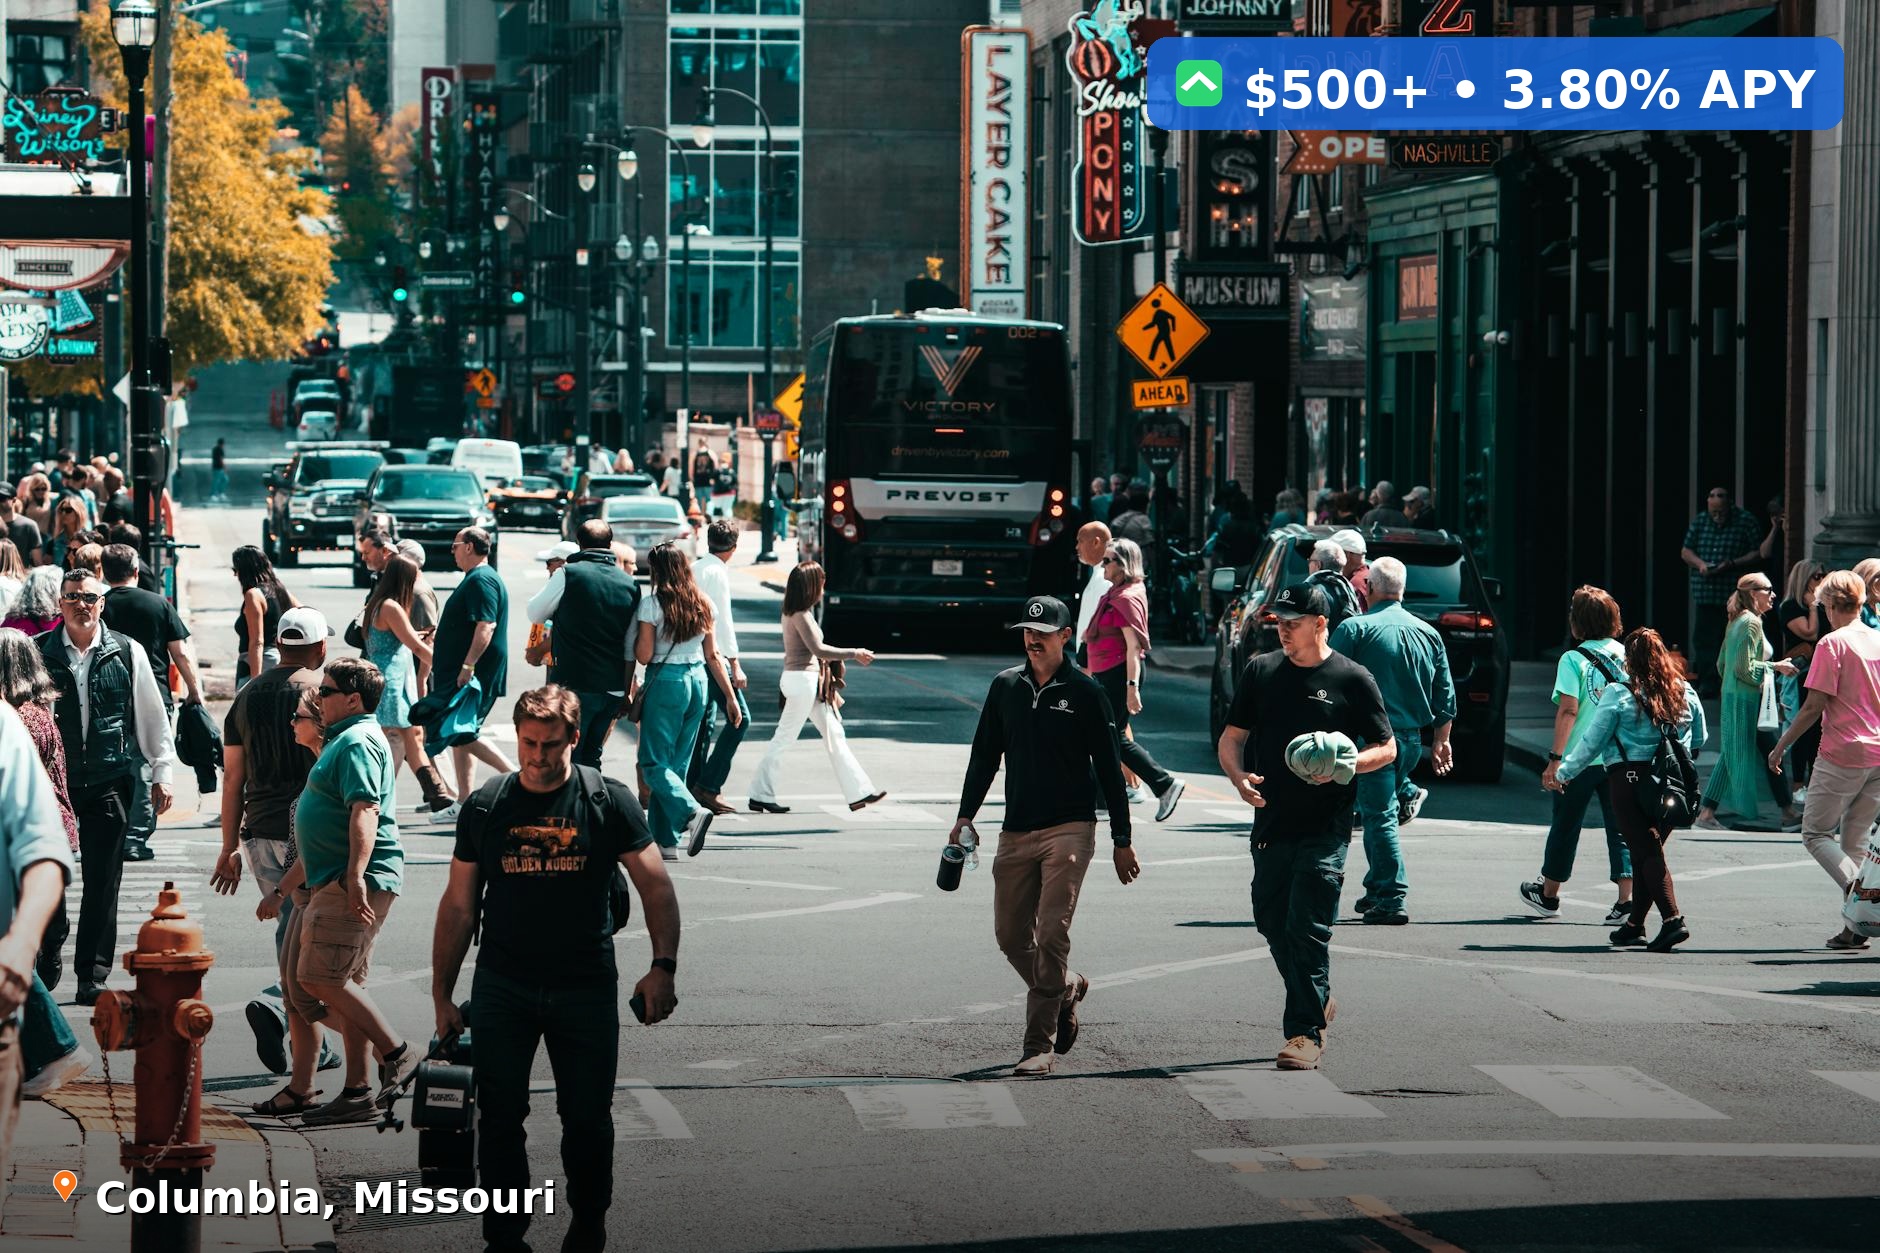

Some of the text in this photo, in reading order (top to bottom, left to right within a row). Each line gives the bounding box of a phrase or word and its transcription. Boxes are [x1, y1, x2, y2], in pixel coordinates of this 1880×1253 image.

[1404, 141, 1492, 163] NASHVILLE
[479, 133, 493, 211] HYATT
[985, 45, 1012, 285] LAYER CAKE
[1091, 112, 1114, 231] PONY
[21, 263, 47, 272] SINCE
[1184, 276, 1282, 305] MUSEUM
[1139, 384, 1184, 401] AHEAD
[903, 401, 996, 412] VICTORY
[886, 489, 1010, 503] PREVOST
[502, 856, 587, 873] GOLDEN NUGGET
